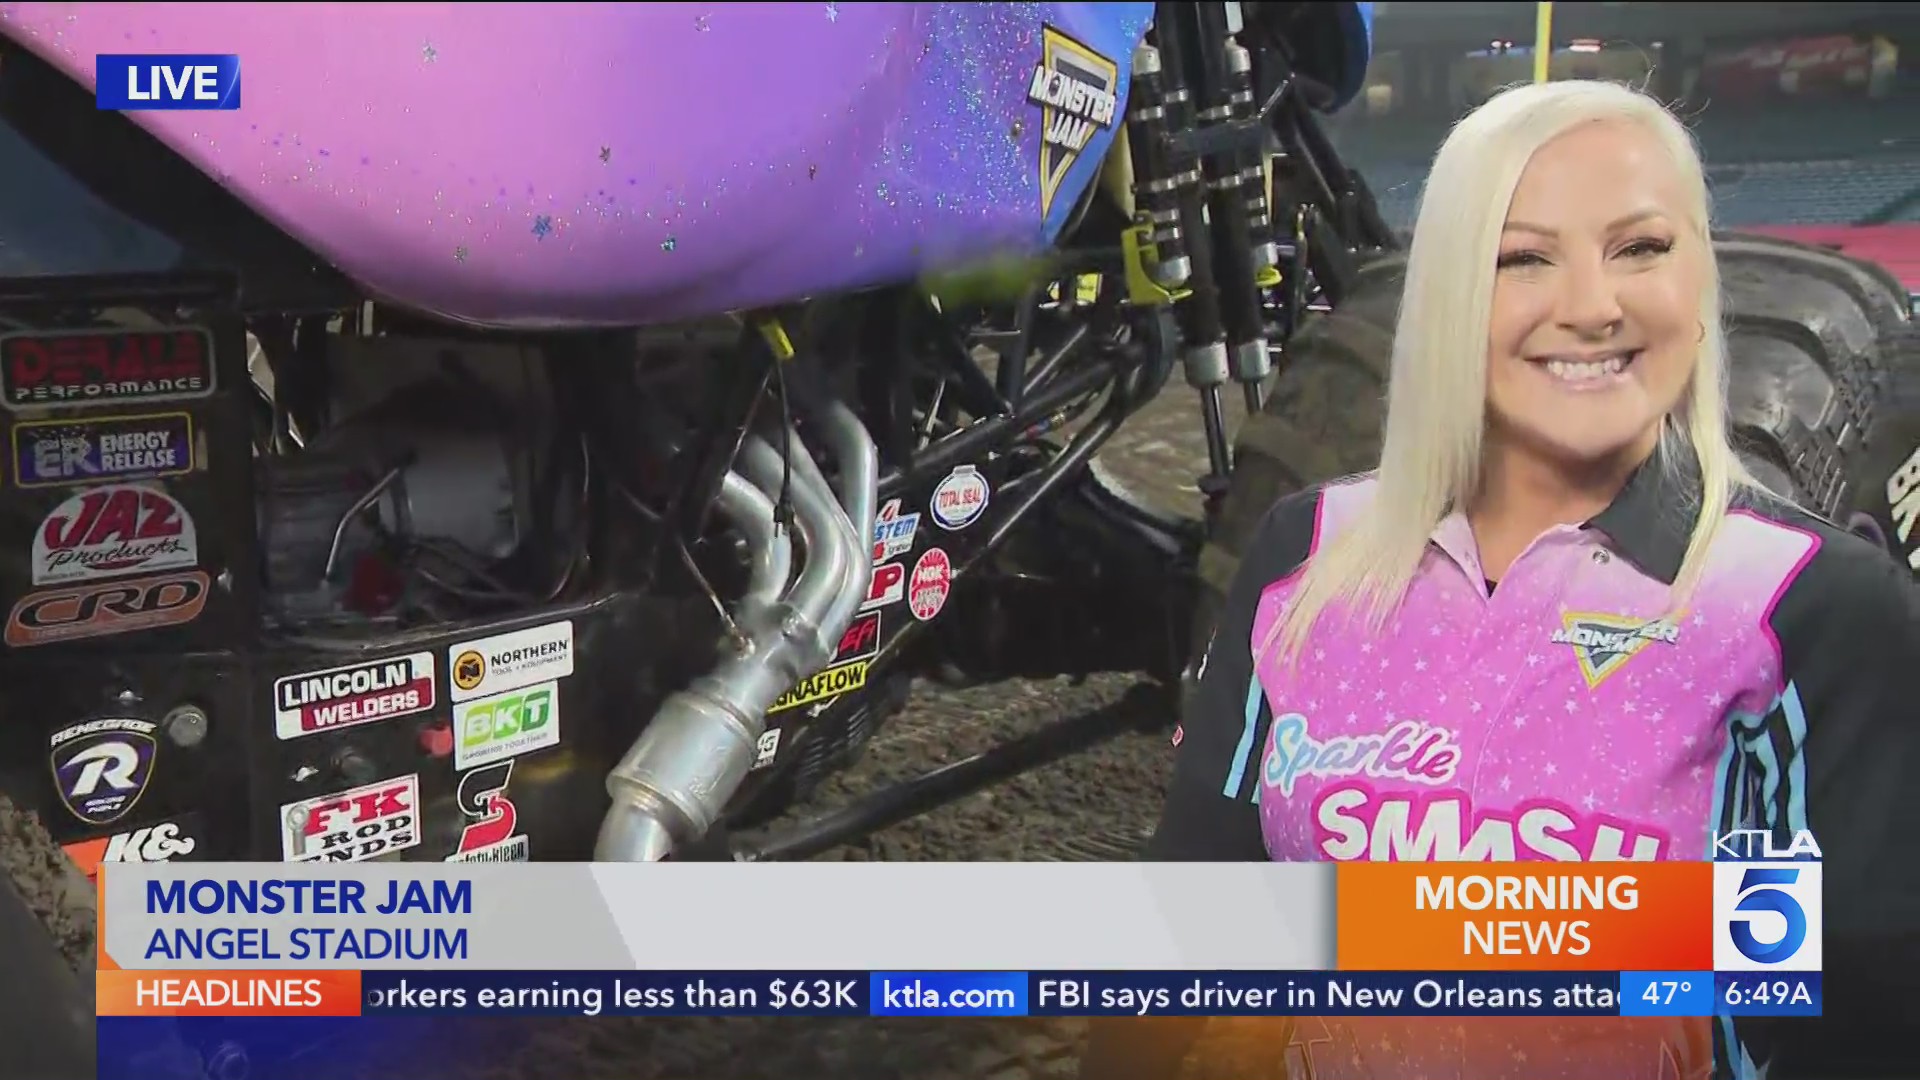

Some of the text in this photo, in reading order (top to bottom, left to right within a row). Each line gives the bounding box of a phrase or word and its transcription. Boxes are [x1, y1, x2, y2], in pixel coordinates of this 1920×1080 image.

[1027, 65, 1116, 127] MONSTER
[1046, 112, 1090, 150] JAM
[12, 331, 200, 390] DERALE
[15, 376, 202, 400] PERFORMANCE
[101, 431, 170, 453] ENERGY
[102, 449, 176, 472] RELEASE
[44, 490, 183, 550] JAZ
[45, 537, 188, 572] Products
[18, 580, 203, 629] CRD
[491, 639, 568, 667] NORTHERN
[284, 662, 407, 708] LINCOLN
[313, 689, 420, 727] WELDERS
[464, 691, 551, 747] BKT
[1266, 714, 1460, 796] Sparkle
[303, 785, 411, 837] FK
[321, 815, 412, 850] ROD
[1318, 788, 1662, 861] SMASH
